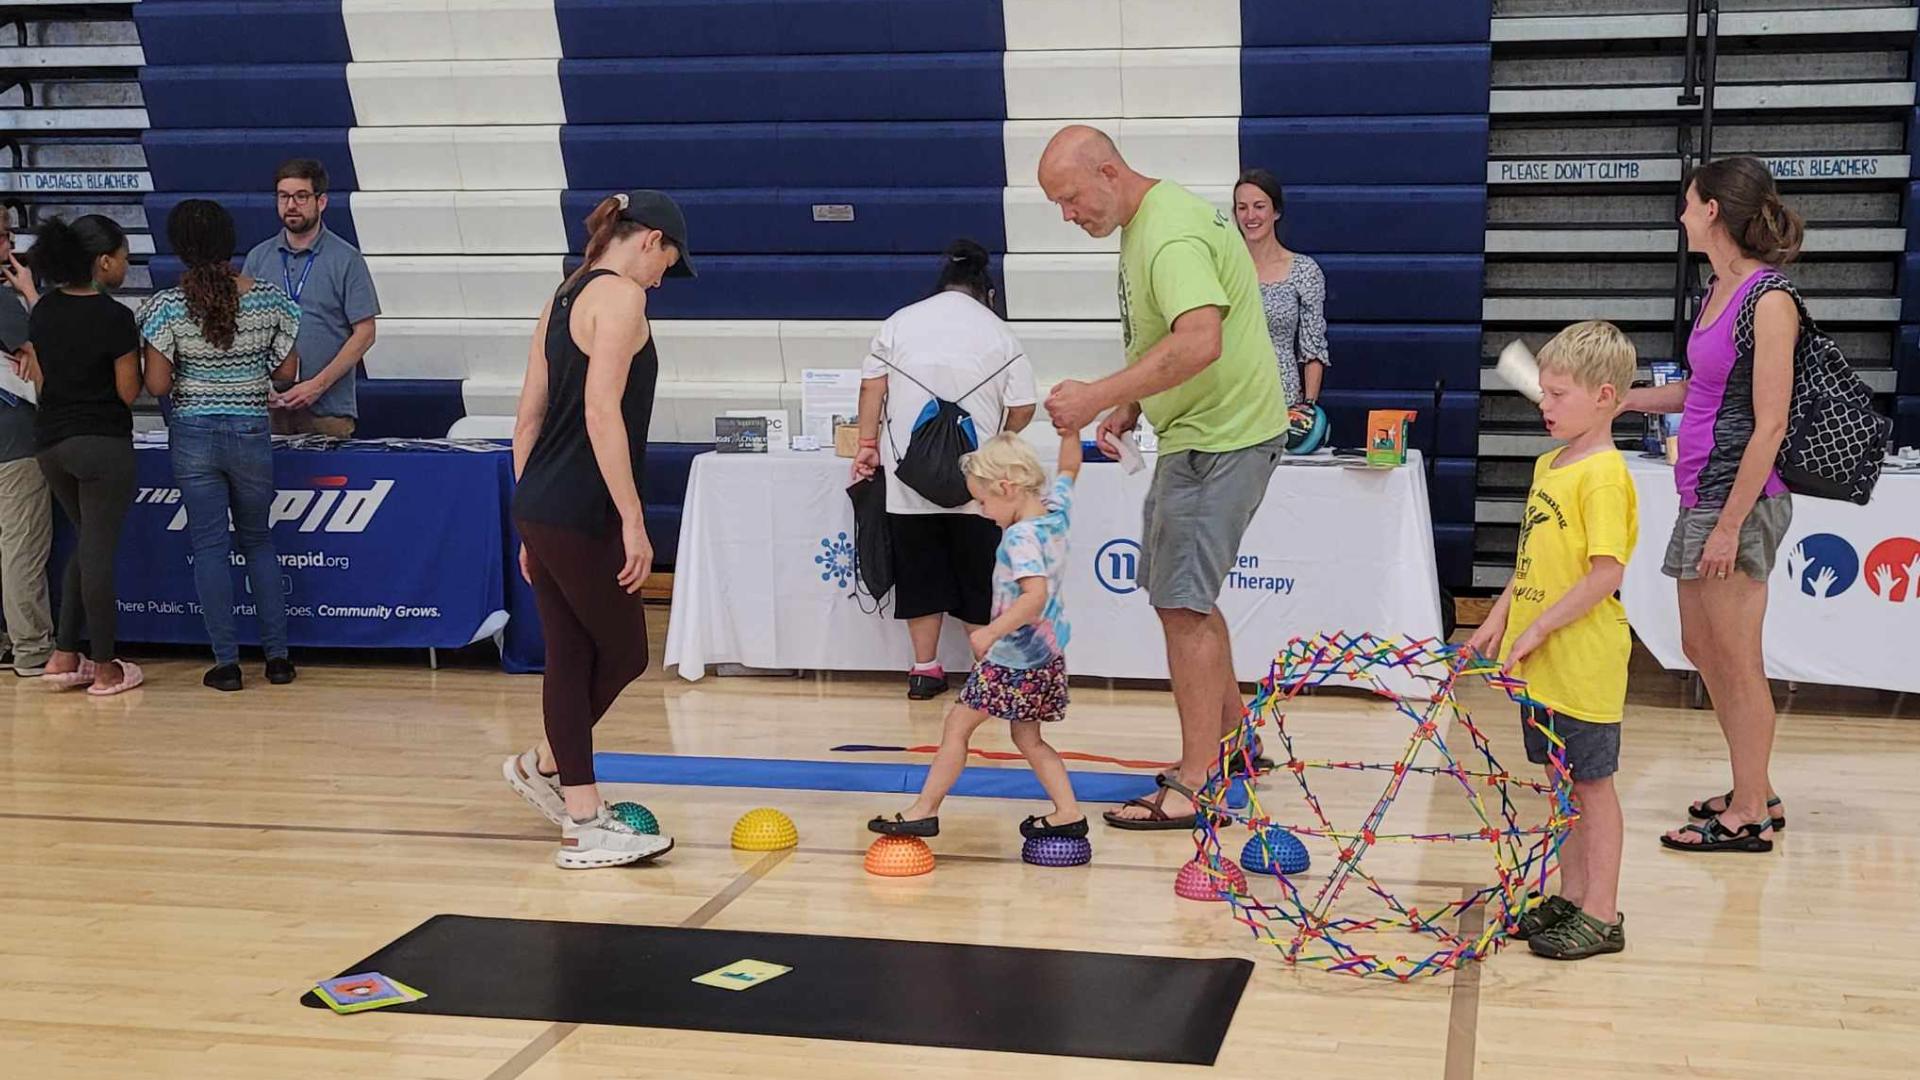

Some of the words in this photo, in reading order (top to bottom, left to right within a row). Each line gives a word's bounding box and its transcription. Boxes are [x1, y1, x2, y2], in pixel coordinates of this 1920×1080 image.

[1501, 163, 1548, 180] PLEASE
[1554, 163, 1596, 179] DON'T
[1599, 162, 1640, 179] CLIMB
[1765, 160, 1805, 177] MAGES
[1810, 158, 1878, 176] BLEACHERS
[19, 174, 31, 188] IT
[86, 174, 139, 189] BLEACHERS
[1226, 572, 1295, 595] Therapy
[148, 601, 185, 614] Public
[318, 604, 392, 620] Community
[395, 605, 441, 617] Grows.
